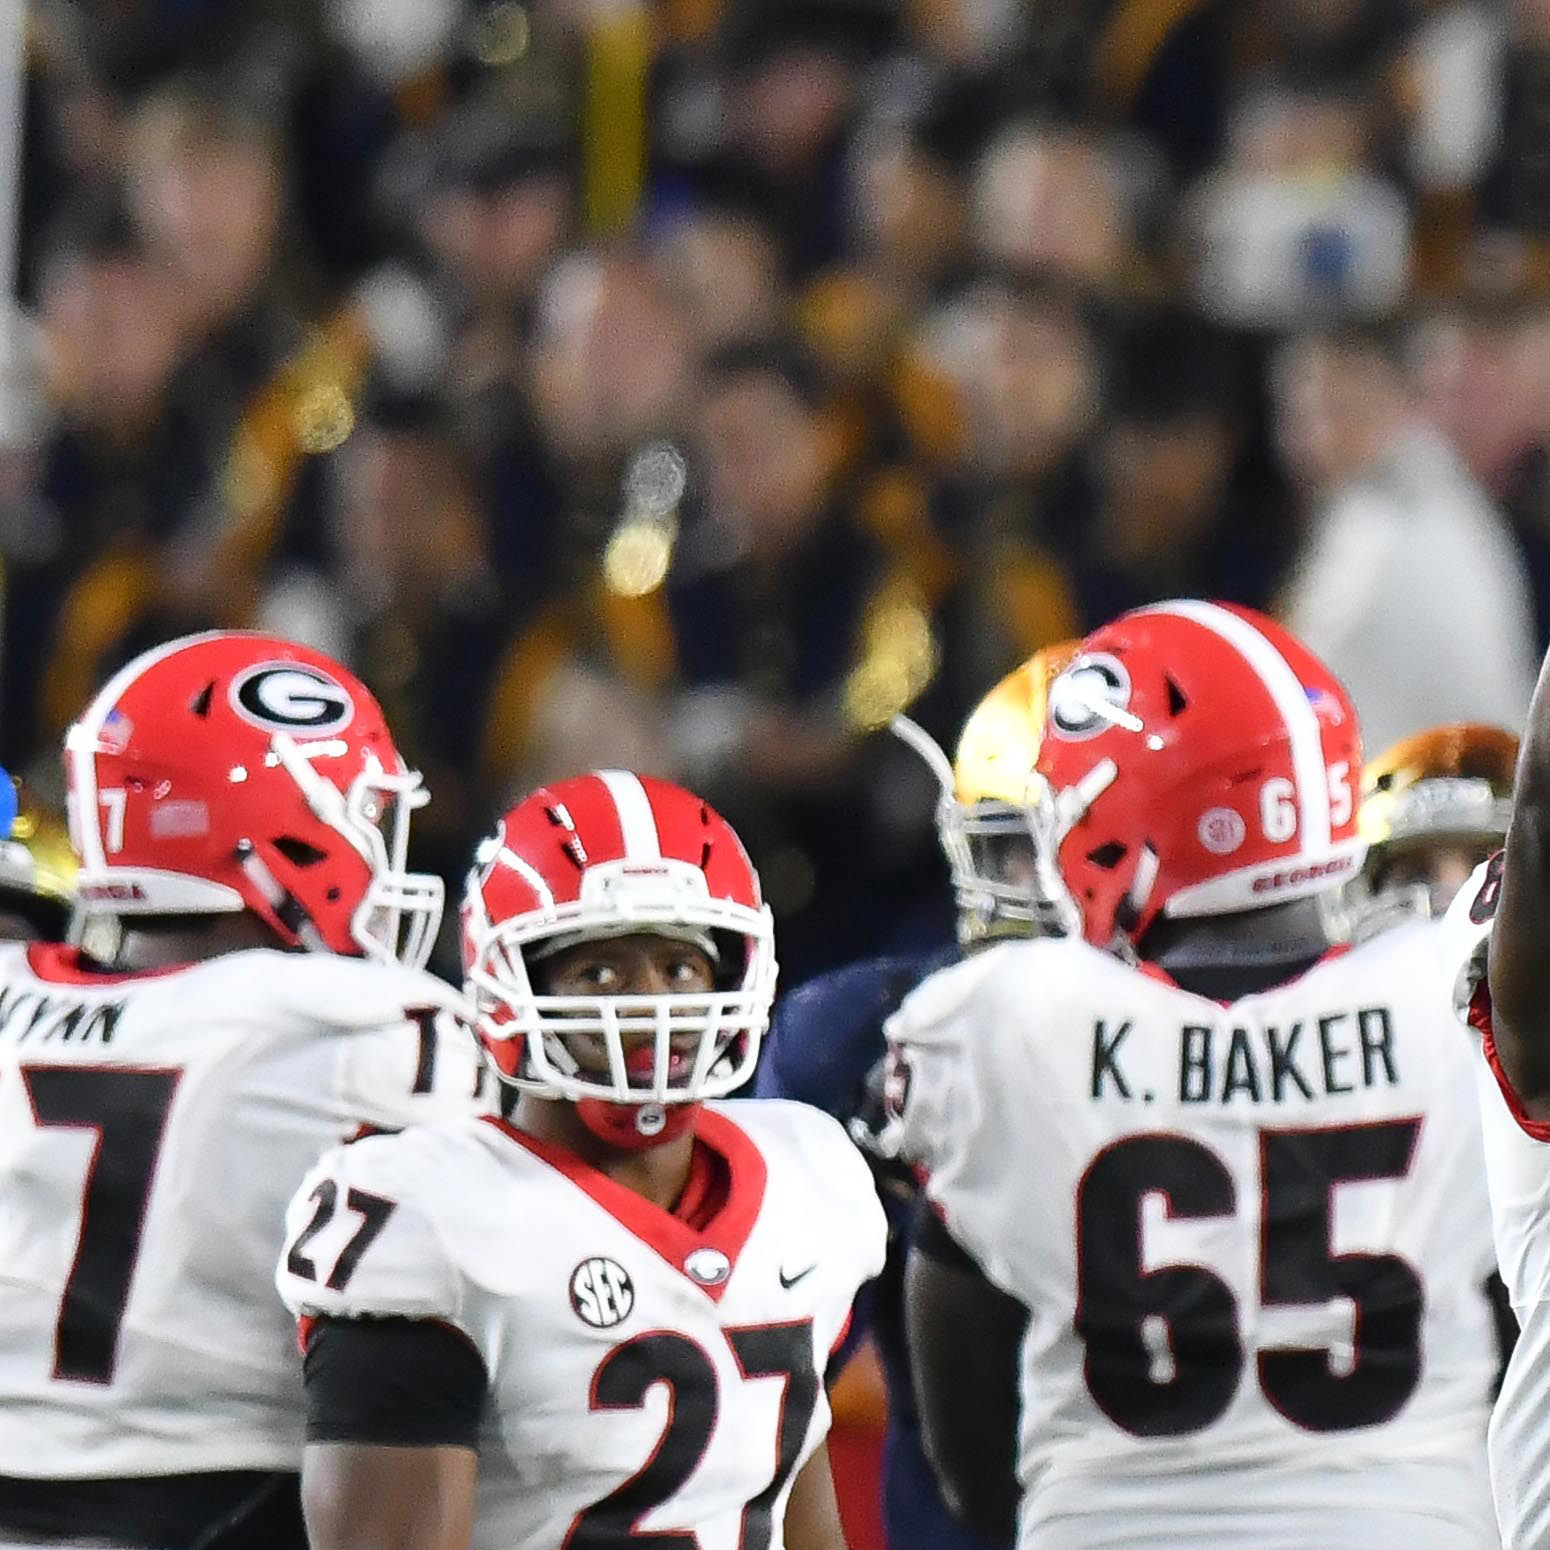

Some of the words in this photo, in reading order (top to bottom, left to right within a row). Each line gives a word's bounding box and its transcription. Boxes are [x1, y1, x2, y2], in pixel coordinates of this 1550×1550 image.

[235, 666, 349, 730] G
[99, 787, 127, 854] 7
[1090, 1019, 1154, 1104] K.
[1179, 1007, 1401, 1104] BAKER
[286, 1178, 399, 1292] 27
[1074, 1112, 1427, 1438] 65
[570, 1257, 634, 1327] SEC
